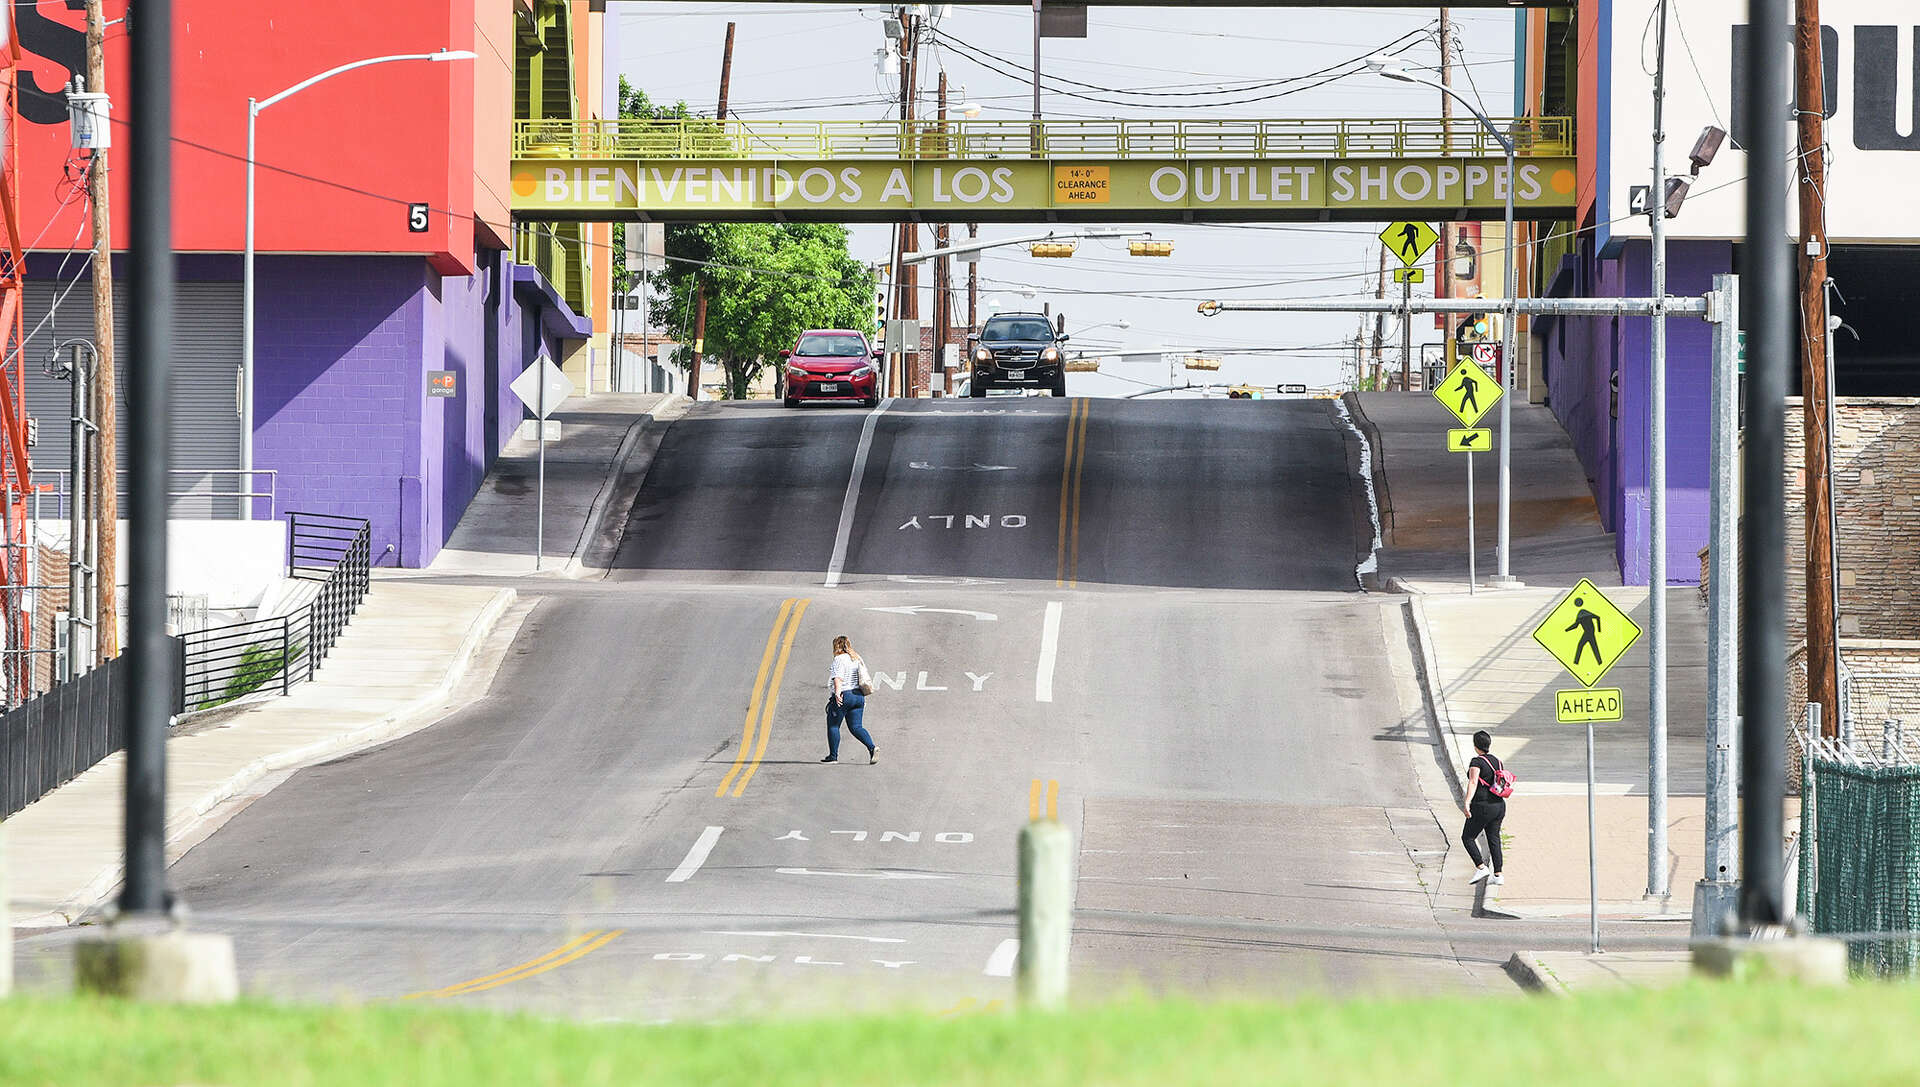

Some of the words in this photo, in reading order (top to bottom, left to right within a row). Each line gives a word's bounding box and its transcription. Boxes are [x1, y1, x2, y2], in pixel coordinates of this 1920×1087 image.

[545, 167, 863, 203] BIENVENIDOS
[880, 167, 912, 202] A
[933, 167, 1015, 203] LOS
[1150, 166, 1316, 202] OUTLET
[1331, 164, 1542, 201] SHOPPES
[1057, 180, 1107, 189] CLEARANCE
[1068, 191, 1096, 200] AHEAD
[1631, 188, 1647, 213] 4
[411, 206, 427, 229] 5
[898, 514, 1027, 530] ONLY
[872, 670, 994, 692] NLY
[1561, 696, 1618, 714] AHEAD
[774, 829, 975, 844] ONLY
[652, 952, 920, 968] ONLY
